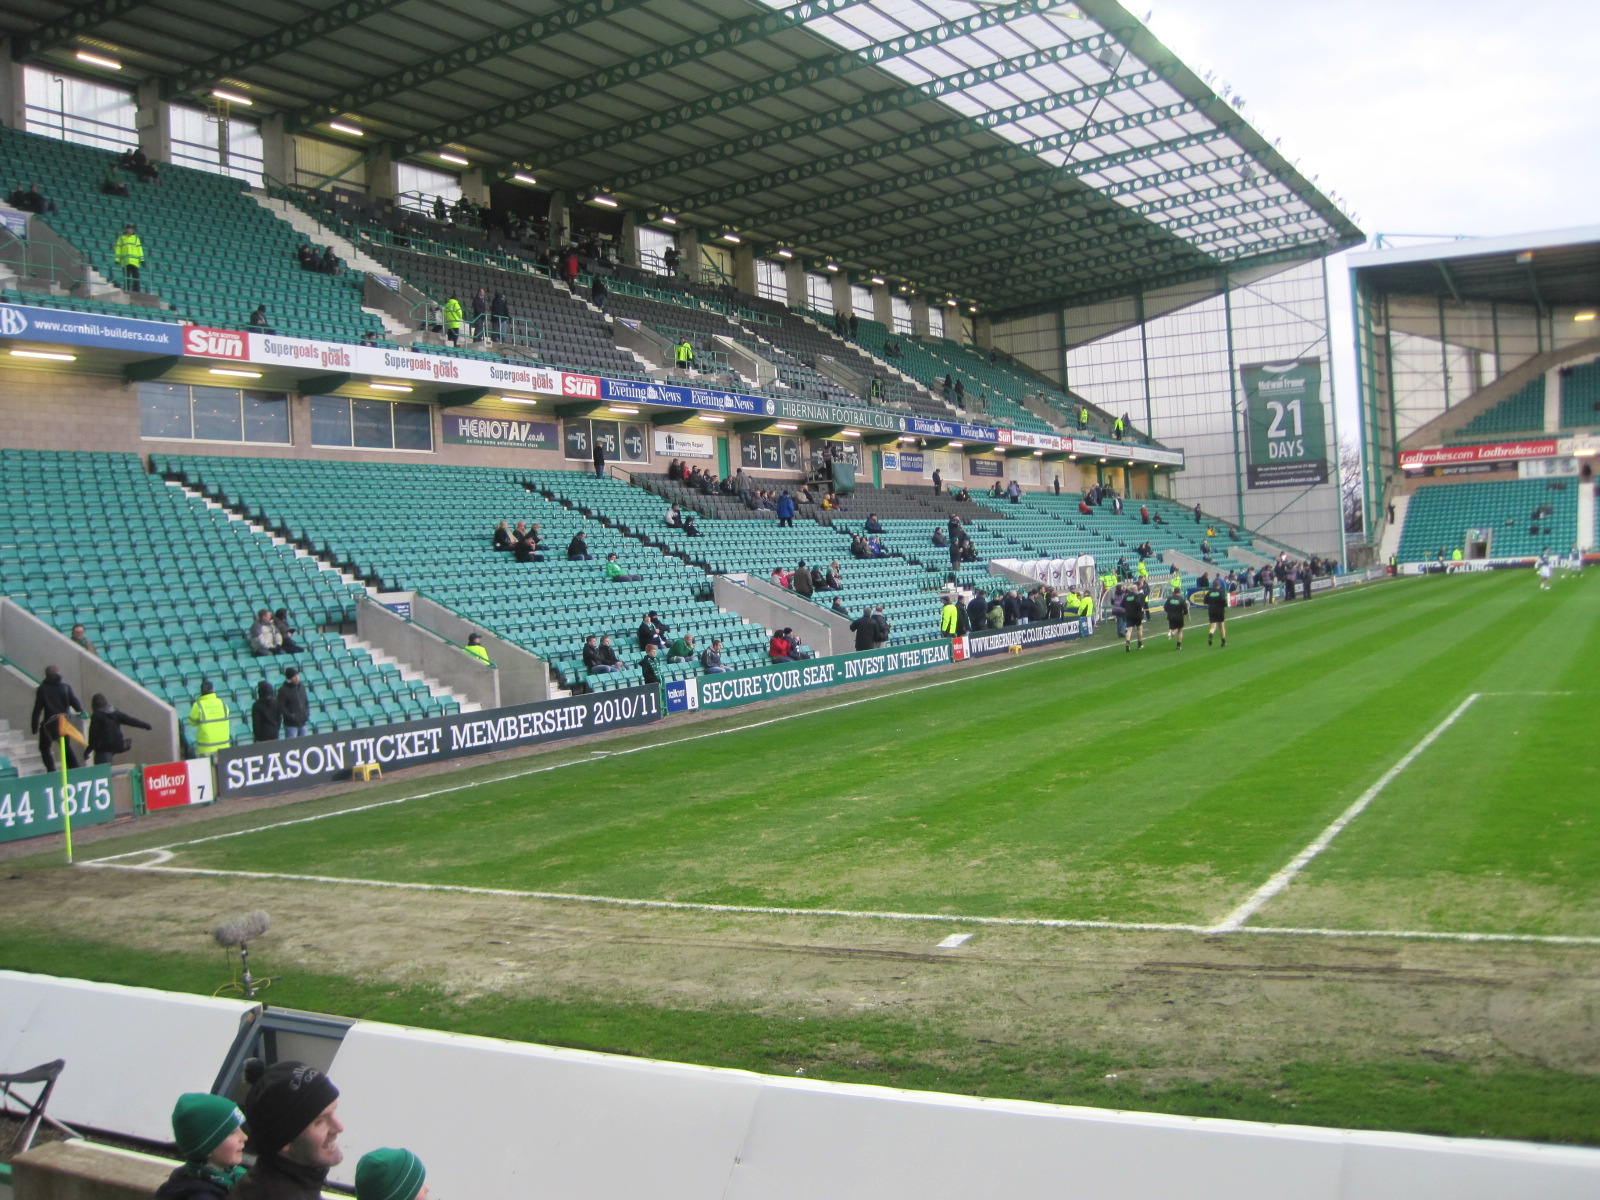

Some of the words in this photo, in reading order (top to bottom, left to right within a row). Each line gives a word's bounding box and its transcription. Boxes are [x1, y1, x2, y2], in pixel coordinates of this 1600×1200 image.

[34, 320, 169, 344] www.cornhill-builders.co.uk
[187, 329, 243, 357] Sun
[264, 339, 319, 359] Supergoals
[321, 347, 350, 367] goals
[384, 353, 431, 372] Supergoals
[433, 360, 459, 379] goals
[490, 366, 531, 383] Supergoals
[531, 373, 554, 390] goals
[564, 376, 597, 397] Sun
[608, 381, 647, 403] Evening
[658, 387, 682, 402] News
[691, 390, 724, 409] Evening
[734, 396, 754, 411] News
[782, 402, 829, 420] HIBERNIAN
[832, 408, 873, 427] FOOTBALL
[875, 414, 894, 428] CLUB
[1267, 399, 1302, 438] 21
[914, 420, 935, 435] Evening
[940, 423, 953, 435] News
[960, 426, 979, 440] Evening
[984, 429, 996, 439] News
[998, 431, 1011, 443] Sun
[576, 432, 587, 450] 75
[605, 434, 615, 452] 75
[632, 436, 642, 454] 75
[675, 440, 691, 448] Property
[1269, 439, 1304, 459] DAYS
[1400, 450, 1473, 464] Ladbrokes.com
[1478, 444, 1553, 458] Ladbrokes.com
[703, 675, 762, 704] SECURE
[762, 668, 801, 692] YOUR
[803, 663, 835, 686] SEAT
[845, 655, 886, 678] INVEST
[887, 653, 899, 670] IN
[900, 650, 920, 668] THE
[922, 644, 949, 664] TEAM
[690, 696, 695, 707] 8
[227, 742, 345, 789] SEASON
[350, 728, 442, 766] TICKET
[451, 704, 587, 750] MEMBERSHIP
[593, 692, 657, 725] 2010/11
[149, 774, 186, 790] talk107
[197, 785, 205, 800] 7
[45, 778, 111, 820] 1875
